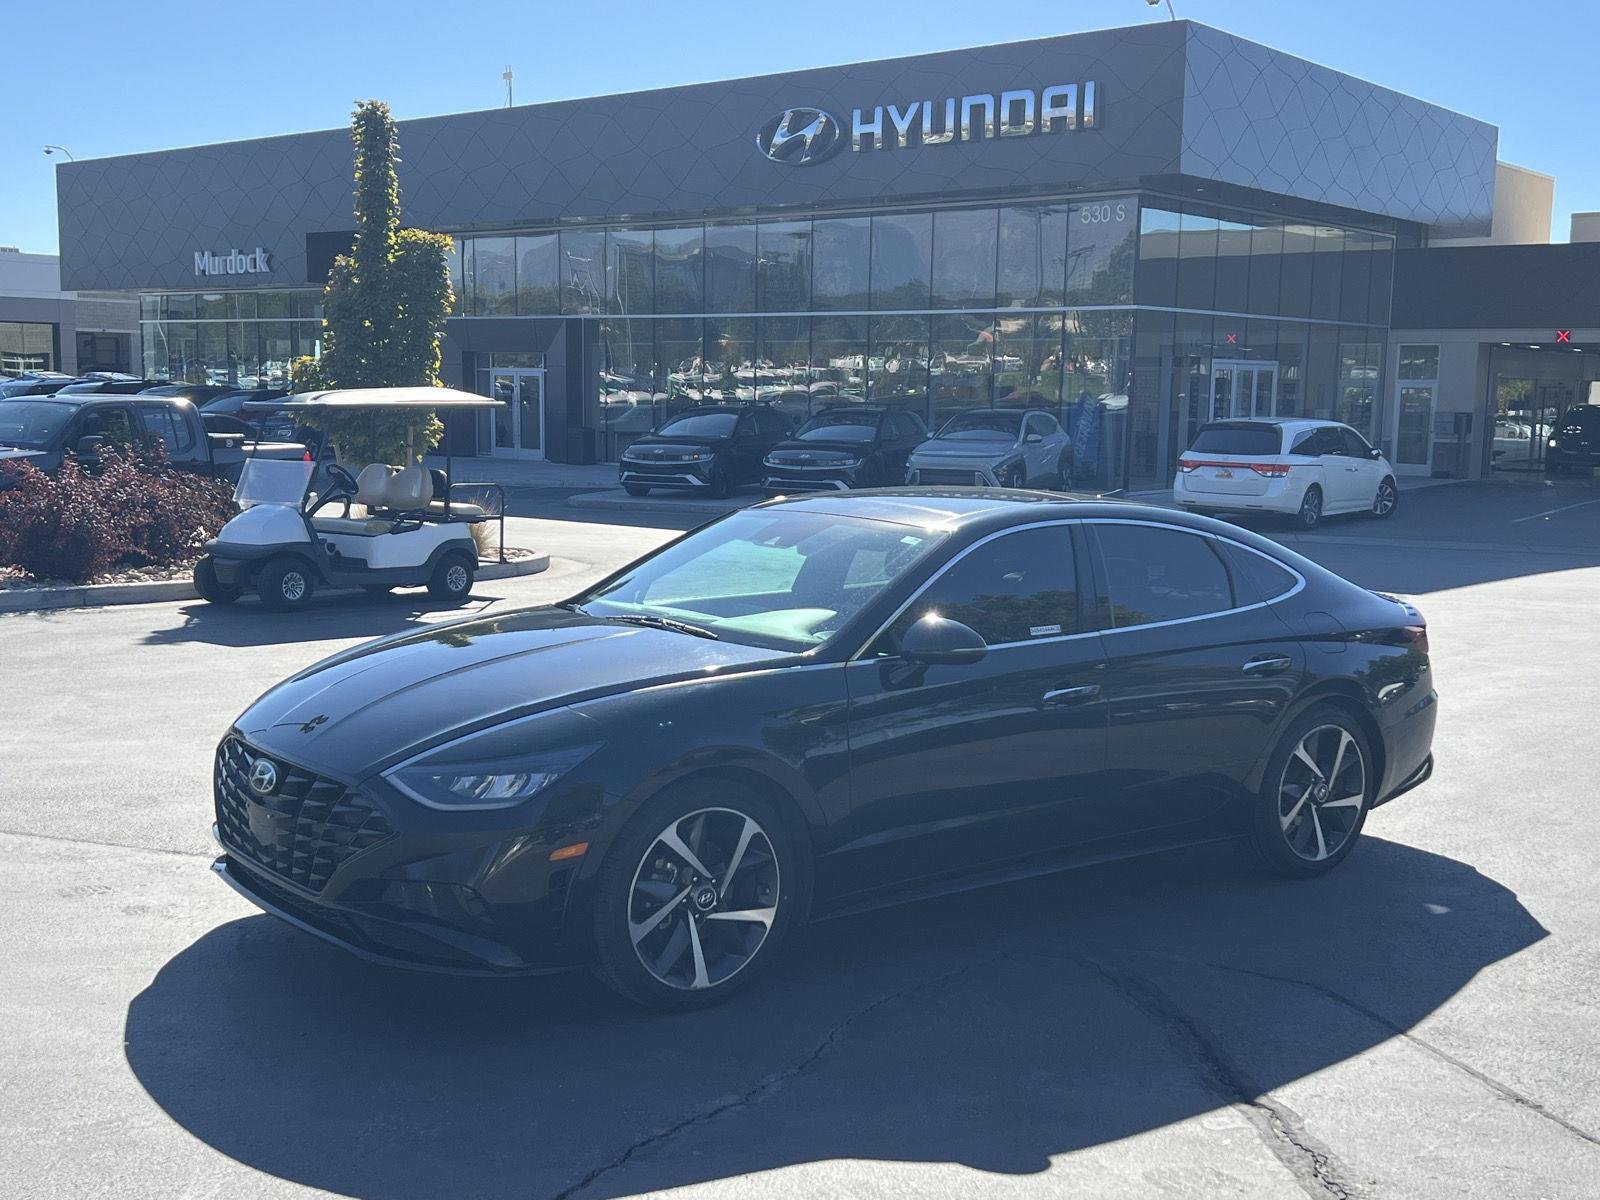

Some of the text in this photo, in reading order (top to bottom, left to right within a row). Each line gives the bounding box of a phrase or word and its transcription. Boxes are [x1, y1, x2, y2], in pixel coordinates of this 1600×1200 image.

[851, 80, 1097, 152] HYUNDAI
[1081, 203, 1126, 224] 530 S
[194, 247, 271, 276] Murdock
